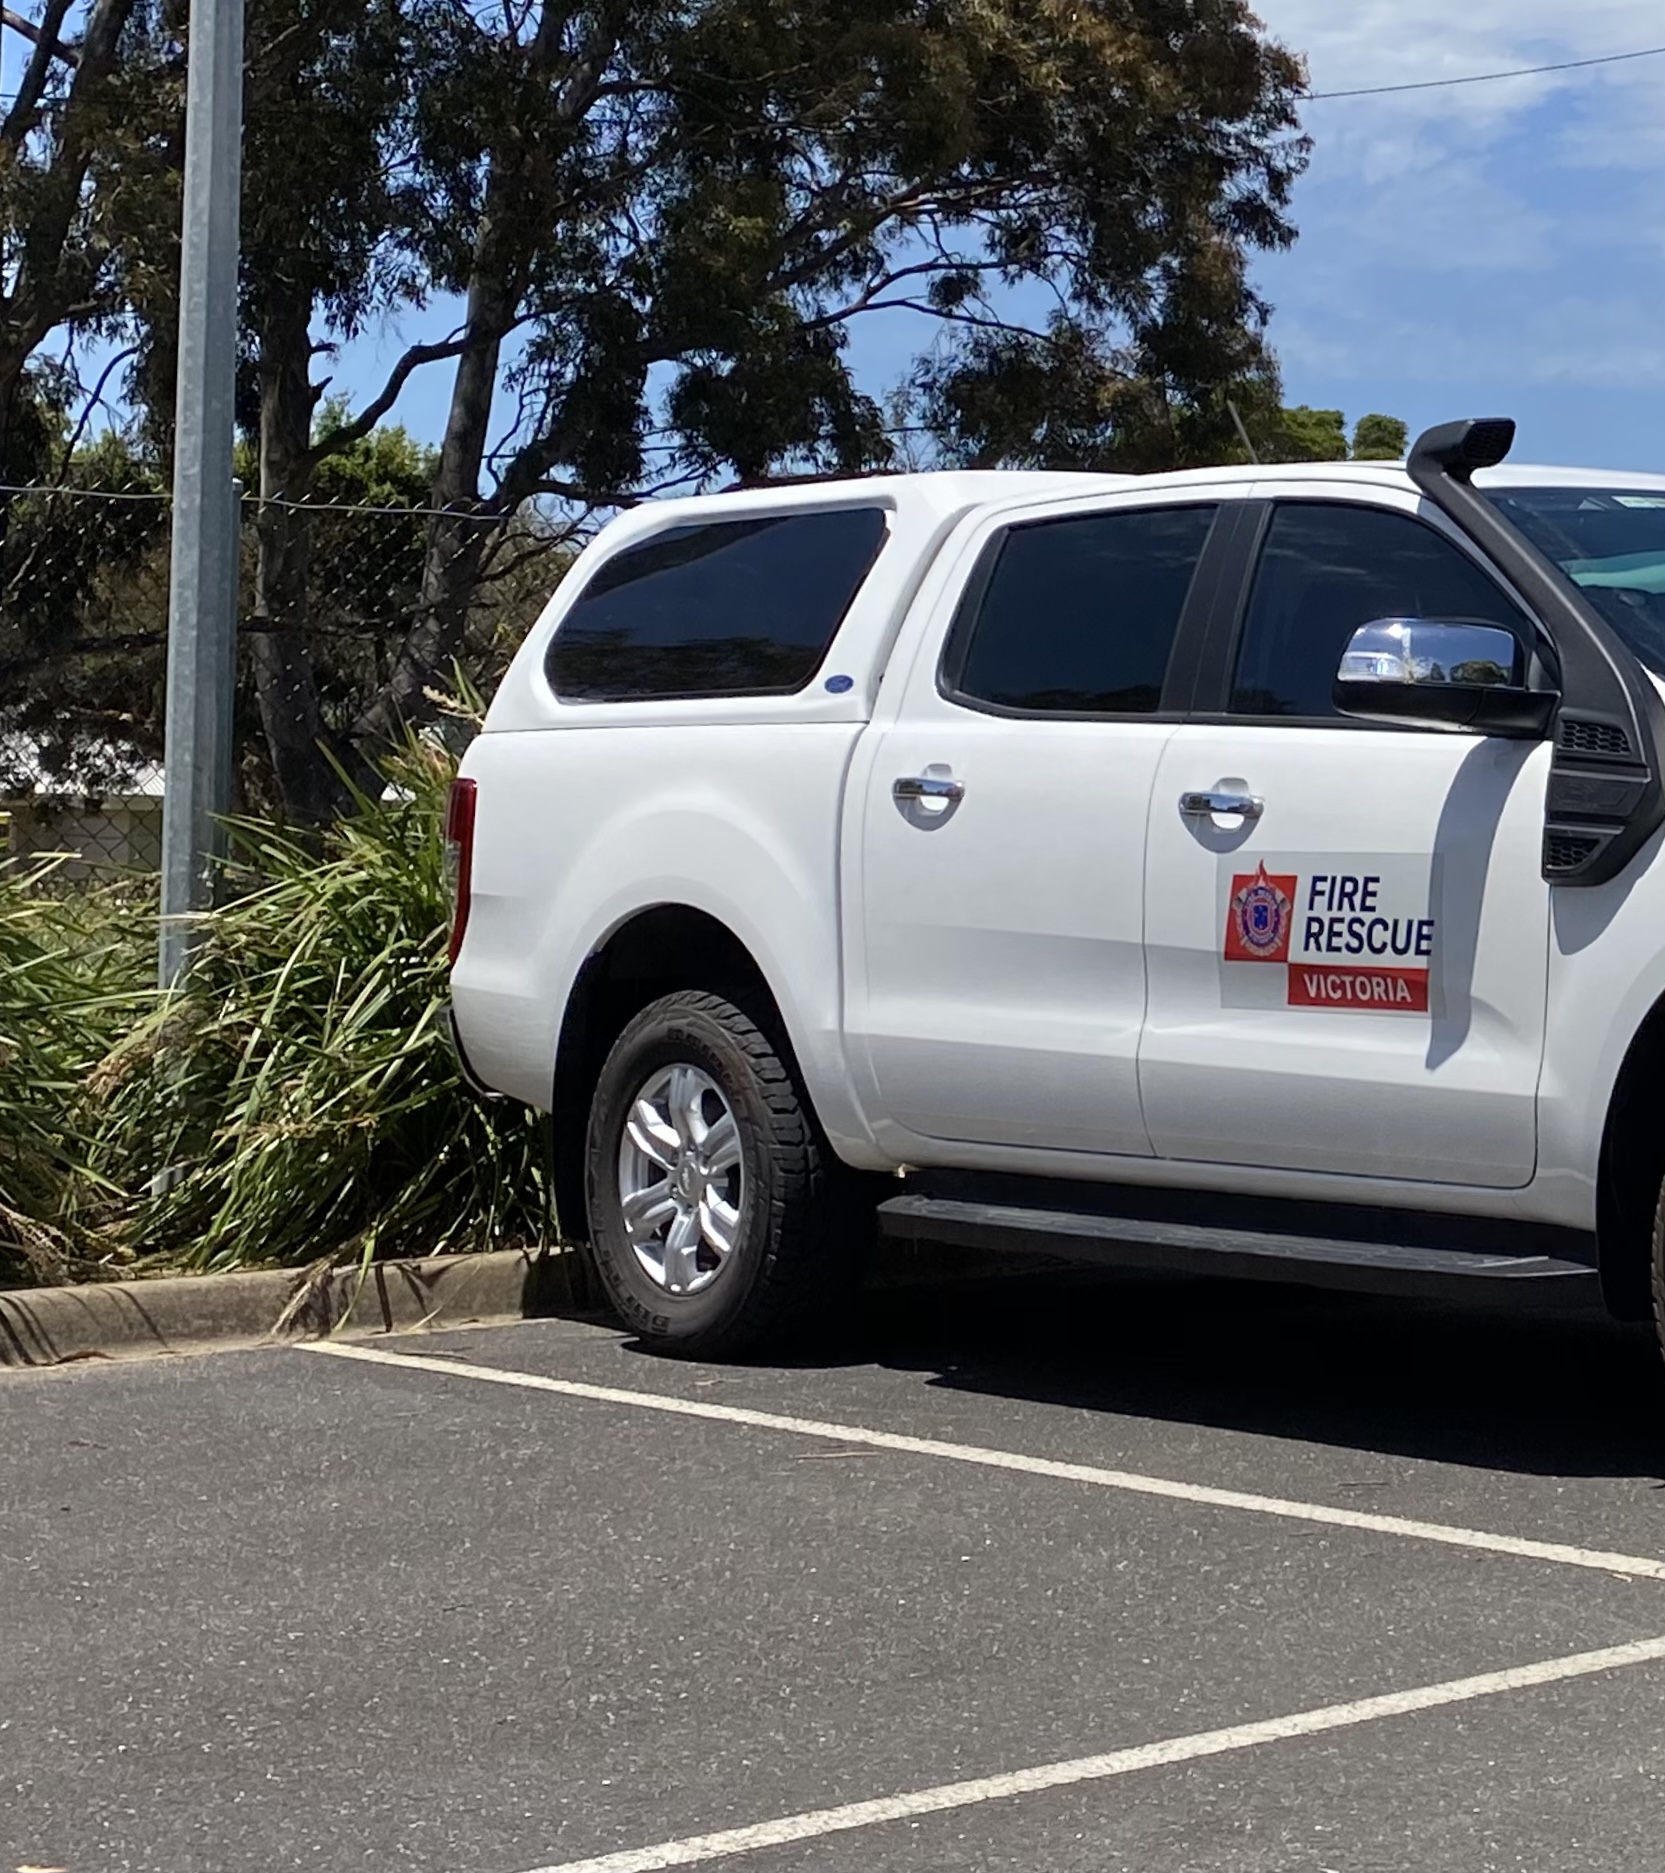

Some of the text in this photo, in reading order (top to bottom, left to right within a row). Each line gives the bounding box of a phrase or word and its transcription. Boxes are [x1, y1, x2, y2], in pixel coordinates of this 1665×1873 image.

[1308, 875, 1381, 912] FIRE
[1303, 916, 1435, 956] RESCUE
[1303, 973, 1413, 1003] VICTORIA
